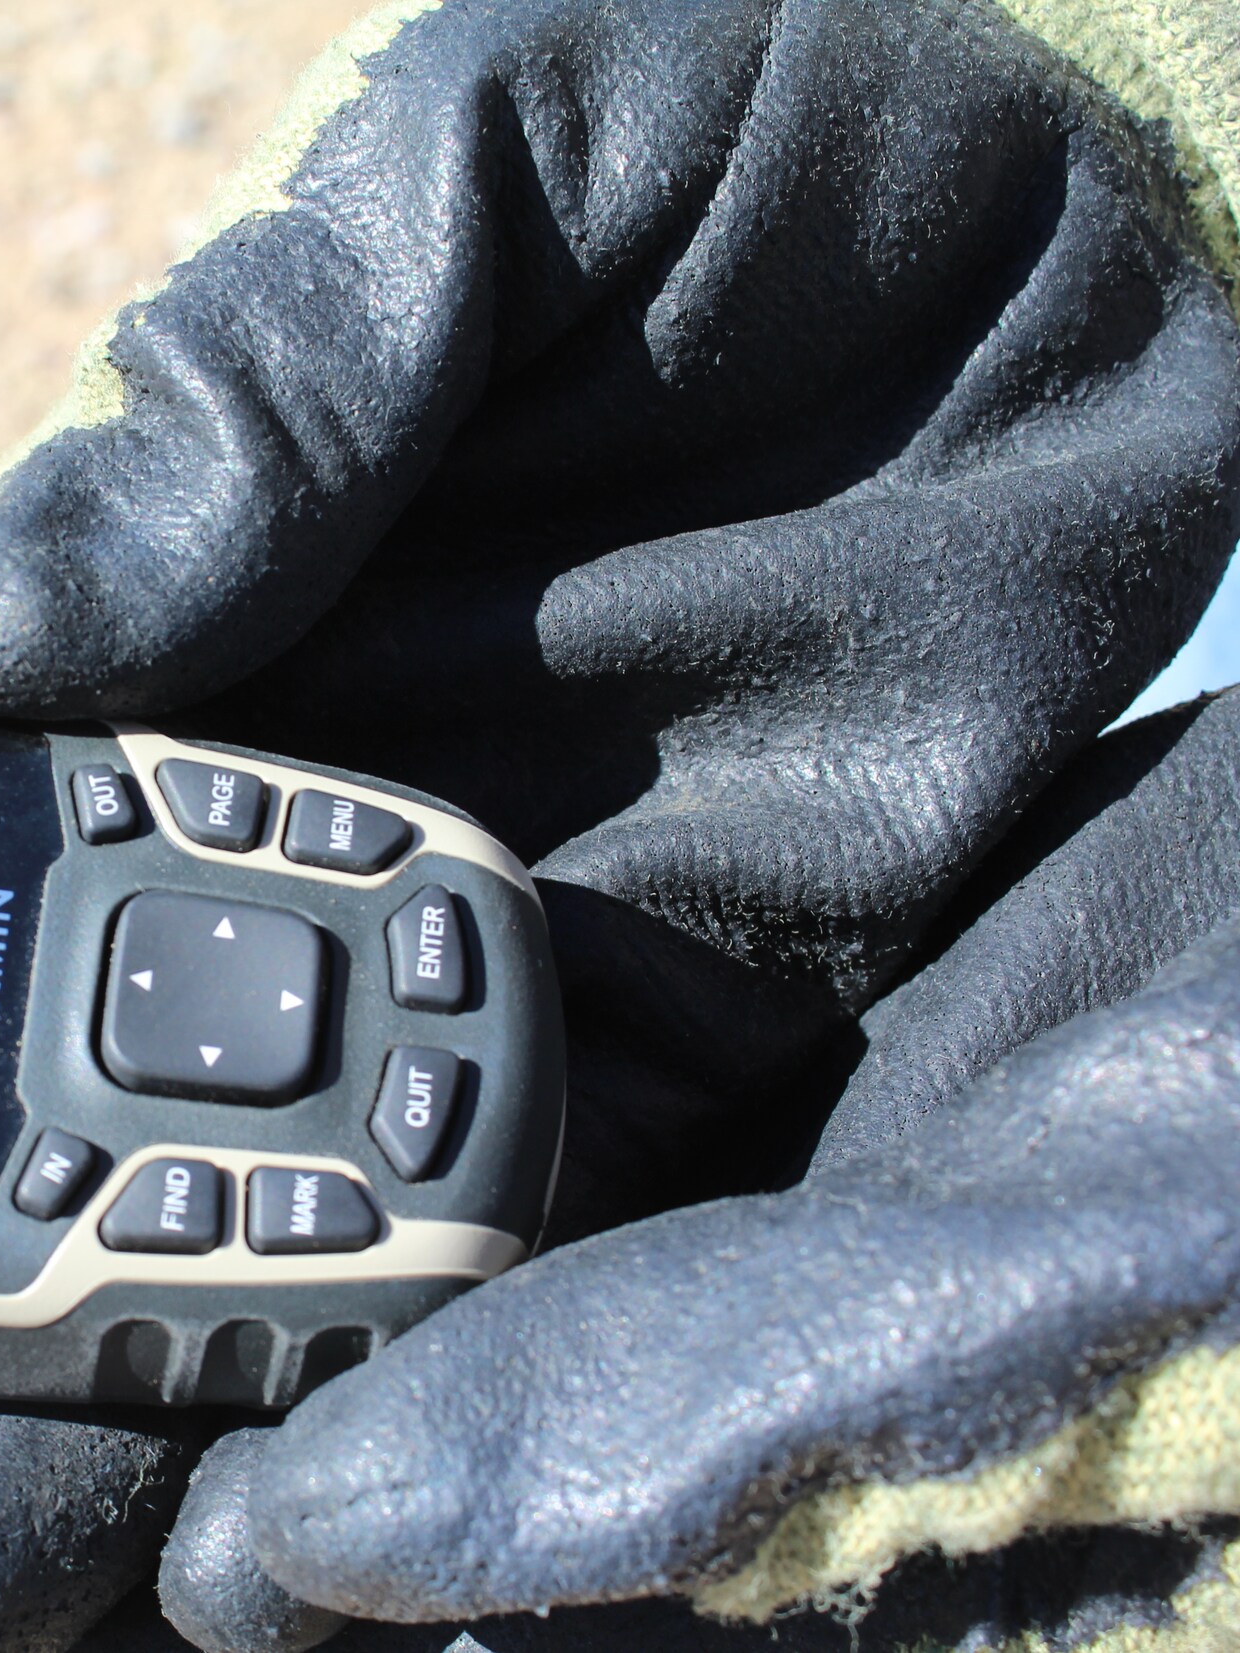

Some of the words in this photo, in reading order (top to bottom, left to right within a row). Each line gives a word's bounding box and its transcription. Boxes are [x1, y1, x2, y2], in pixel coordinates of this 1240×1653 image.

[96, 774, 118, 816] OUT
[208, 773, 235, 827] PAGE
[329, 800, 355, 851] MENU
[416, 905, 446, 980] ENTER
[404, 1066, 433, 1129] QUIT
[40, 1152, 73, 1184] IN
[161, 1166, 190, 1231] FIND
[289, 1174, 319, 1236] MARK
